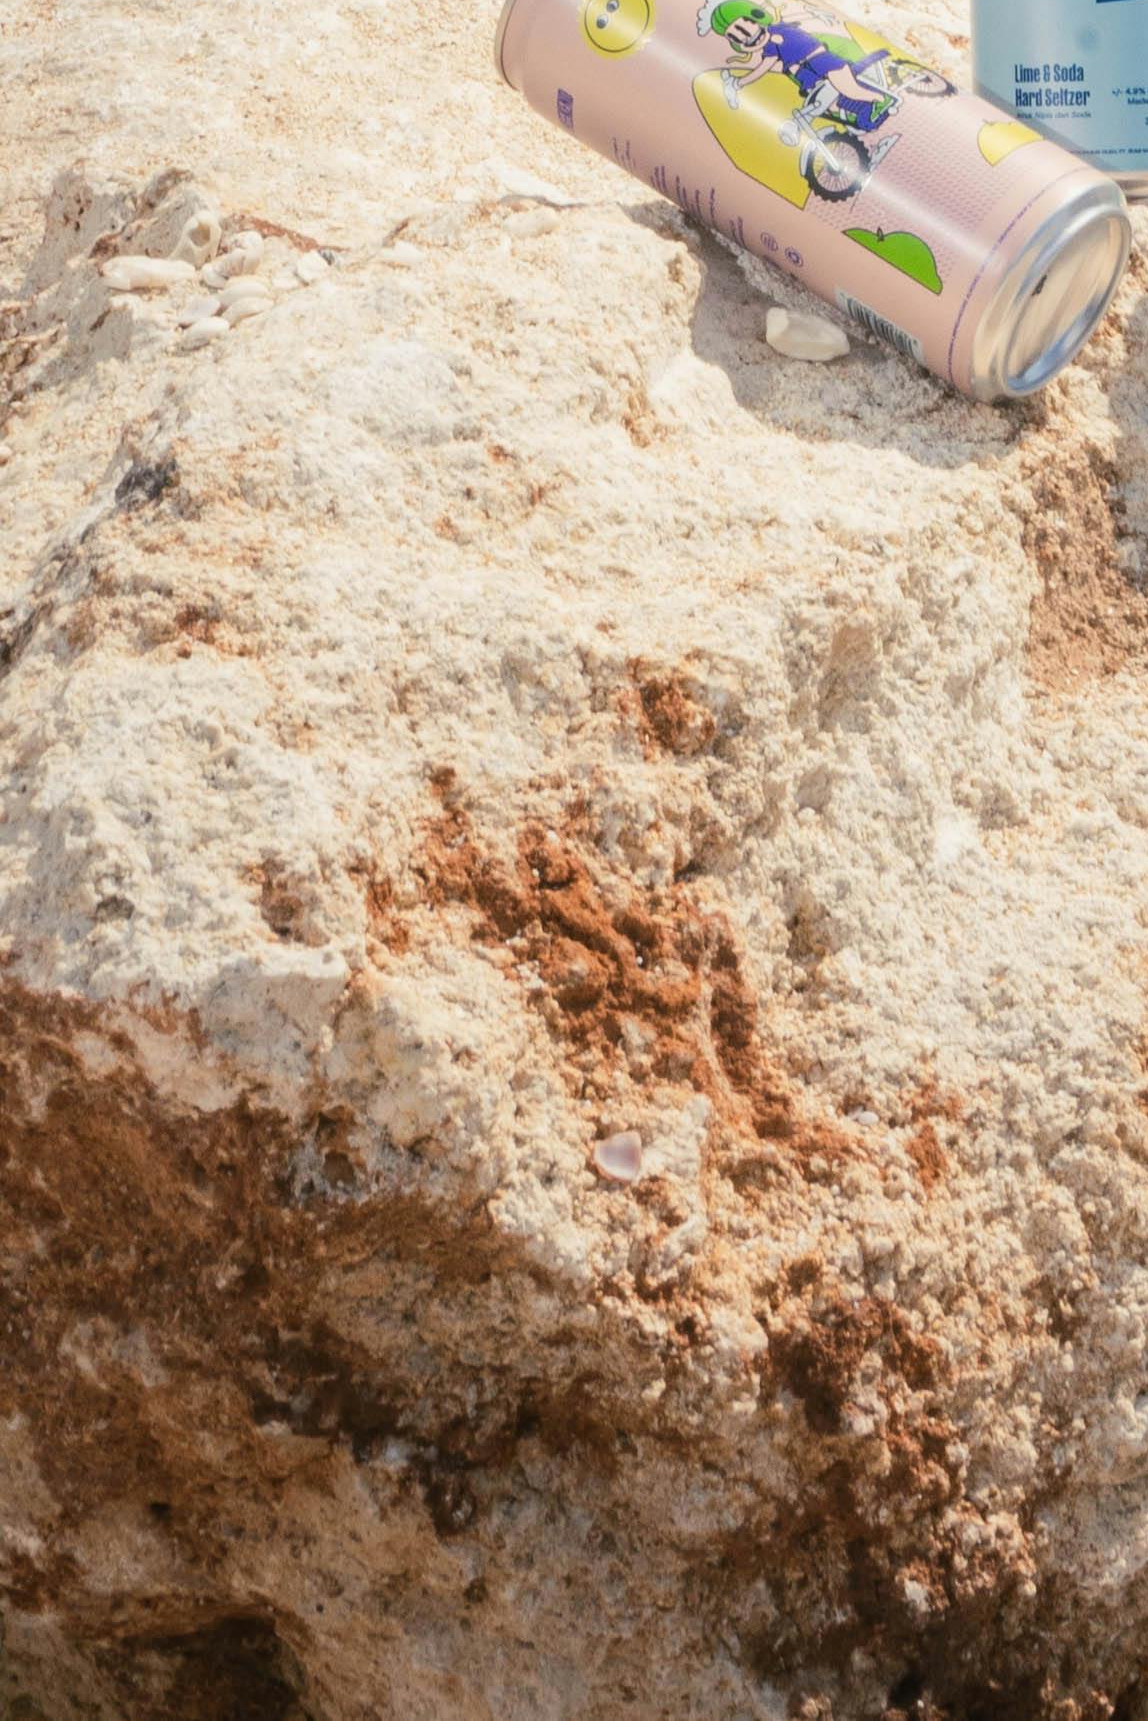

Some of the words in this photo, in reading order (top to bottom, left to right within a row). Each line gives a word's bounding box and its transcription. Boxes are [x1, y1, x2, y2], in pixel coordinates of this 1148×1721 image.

[1014, 64, 1041, 83] Lime
[1043, 64, 1051, 82] &
[1053, 63, 1084, 82] Soda
[1015, 88, 1043, 107] Hard
[1044, 88, 1091, 106] Seltzer
